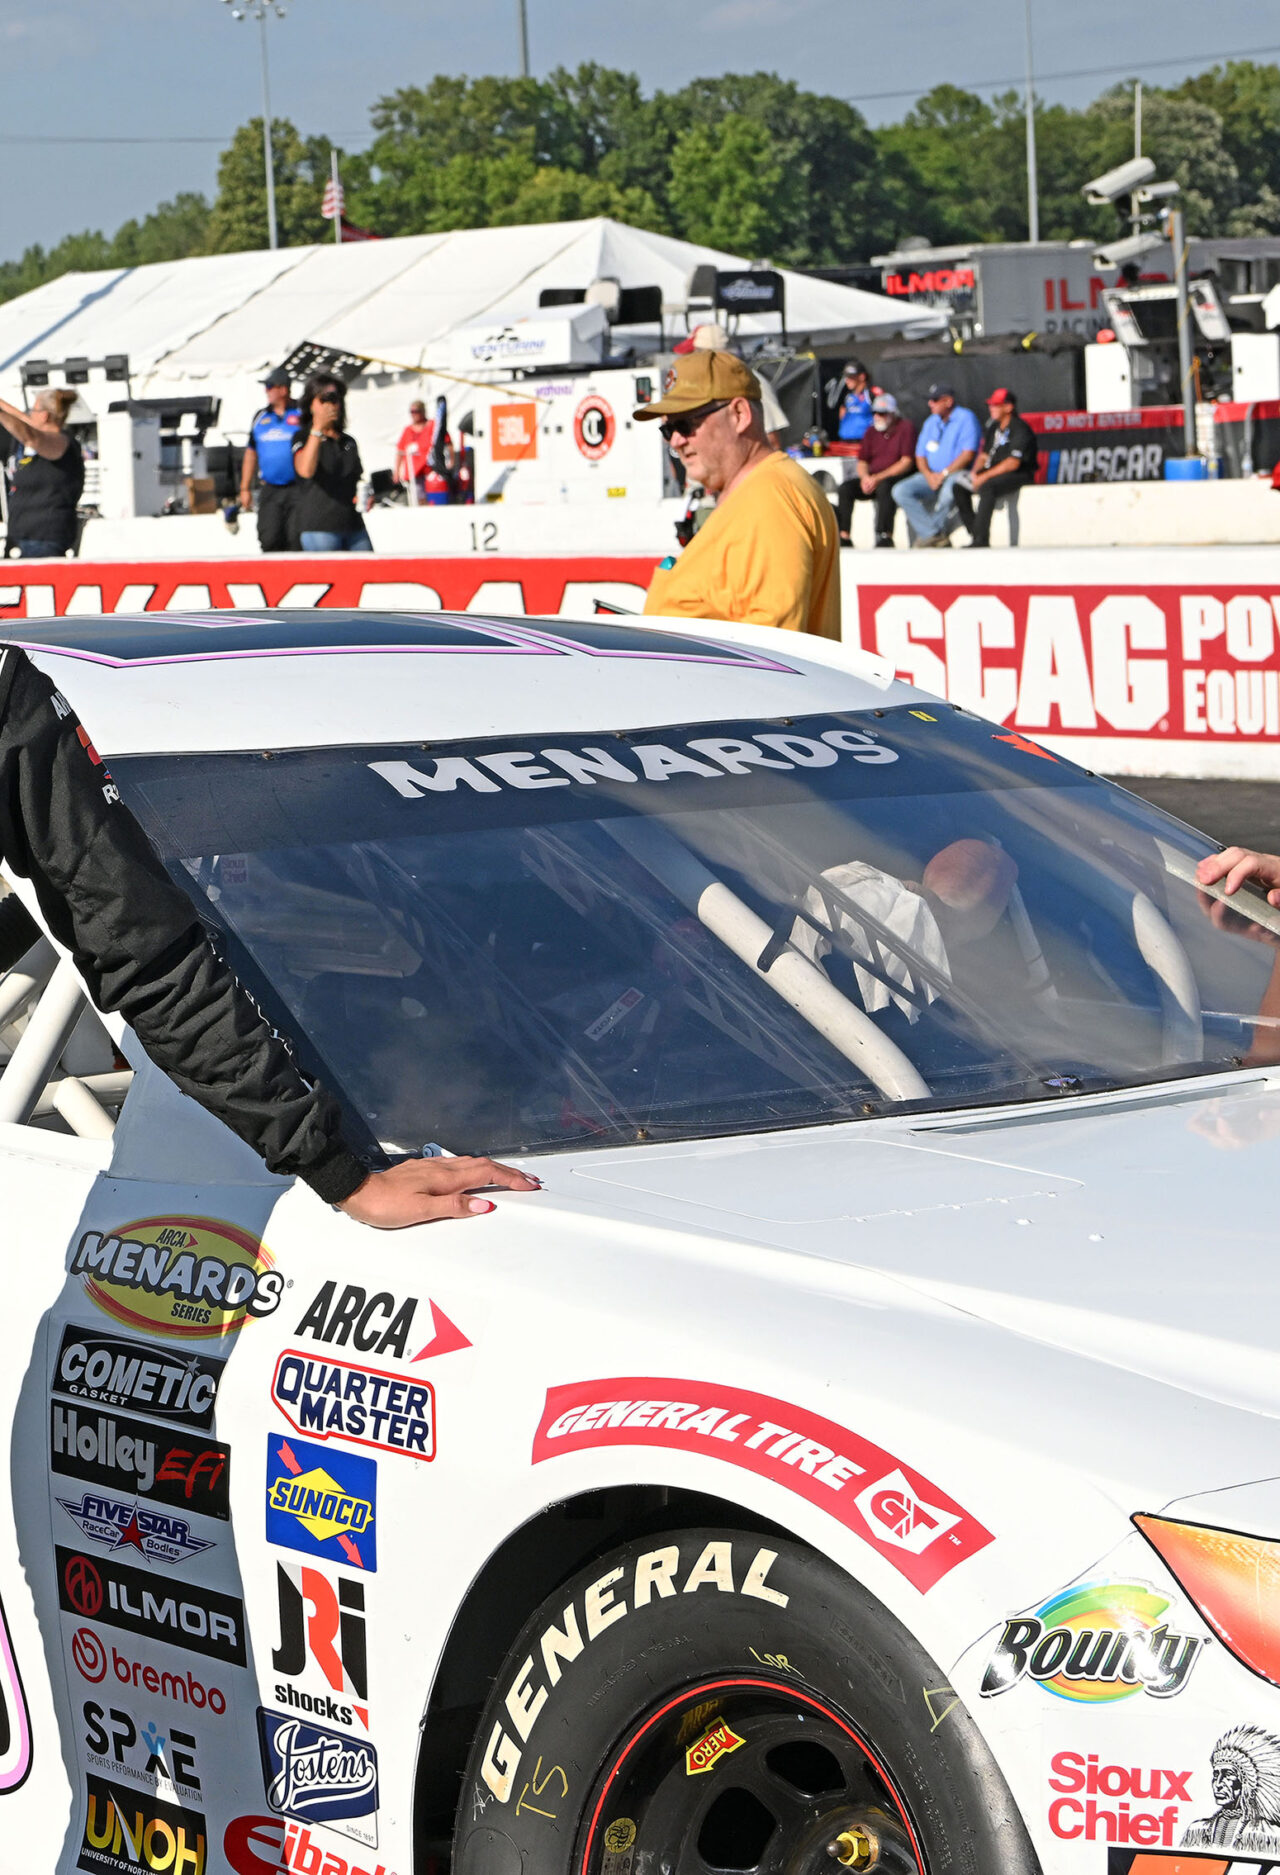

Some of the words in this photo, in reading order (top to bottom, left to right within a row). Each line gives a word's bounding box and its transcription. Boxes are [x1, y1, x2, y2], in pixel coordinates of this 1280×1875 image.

[1097, 412, 1142, 428] ENTER
[1057, 444, 1163, 484] NASCAR
[470, 522, 499, 552] 12
[874, 594, 1170, 731] SCAG
[369, 730, 900, 798] MENARDS
[155, 1228, 185, 1248] ARCA
[71, 1232, 284, 1317] MENARDS
[170, 1302, 212, 1325] SERIES
[293, 1280, 419, 1360] ARCA
[59, 1344, 216, 1416] COMETIC
[68, 1385, 128, 1406] GASKET
[275, 1355, 429, 1420] QUARTER
[54, 1404, 157, 1492] Holley
[299, 1395, 429, 1453] MASTER
[546, 1400, 753, 1447] GENERAL
[741, 1419, 868, 1491] TIRE
[82, 1496, 133, 1526] FIVE
[137, 1510, 189, 1545] STAR
[274, 1480, 370, 1530] SUNOCO
[82, 1520, 120, 1539] RaceCar
[146, 1539, 180, 1557] Bodies
[108, 1580, 238, 1647] ILMOR
[112, 1647, 227, 1716] brembo
[480, 1541, 790, 1803] GENERAL
[979, 1615, 1203, 1698] Bounty
[275, 1683, 354, 1726] shocks
[86, 1752, 111, 1771] SPORTS
[267, 1720, 376, 1813] Jostens
[692, 1727, 727, 1766] AERO
[1048, 1751, 1193, 1801] Sioux
[86, 1790, 205, 1875] UNOH
[1048, 1797, 1179, 1847] Chief
[81, 1847, 118, 1869] UNIVERSITY
[118, 1861, 128, 1871] OF
